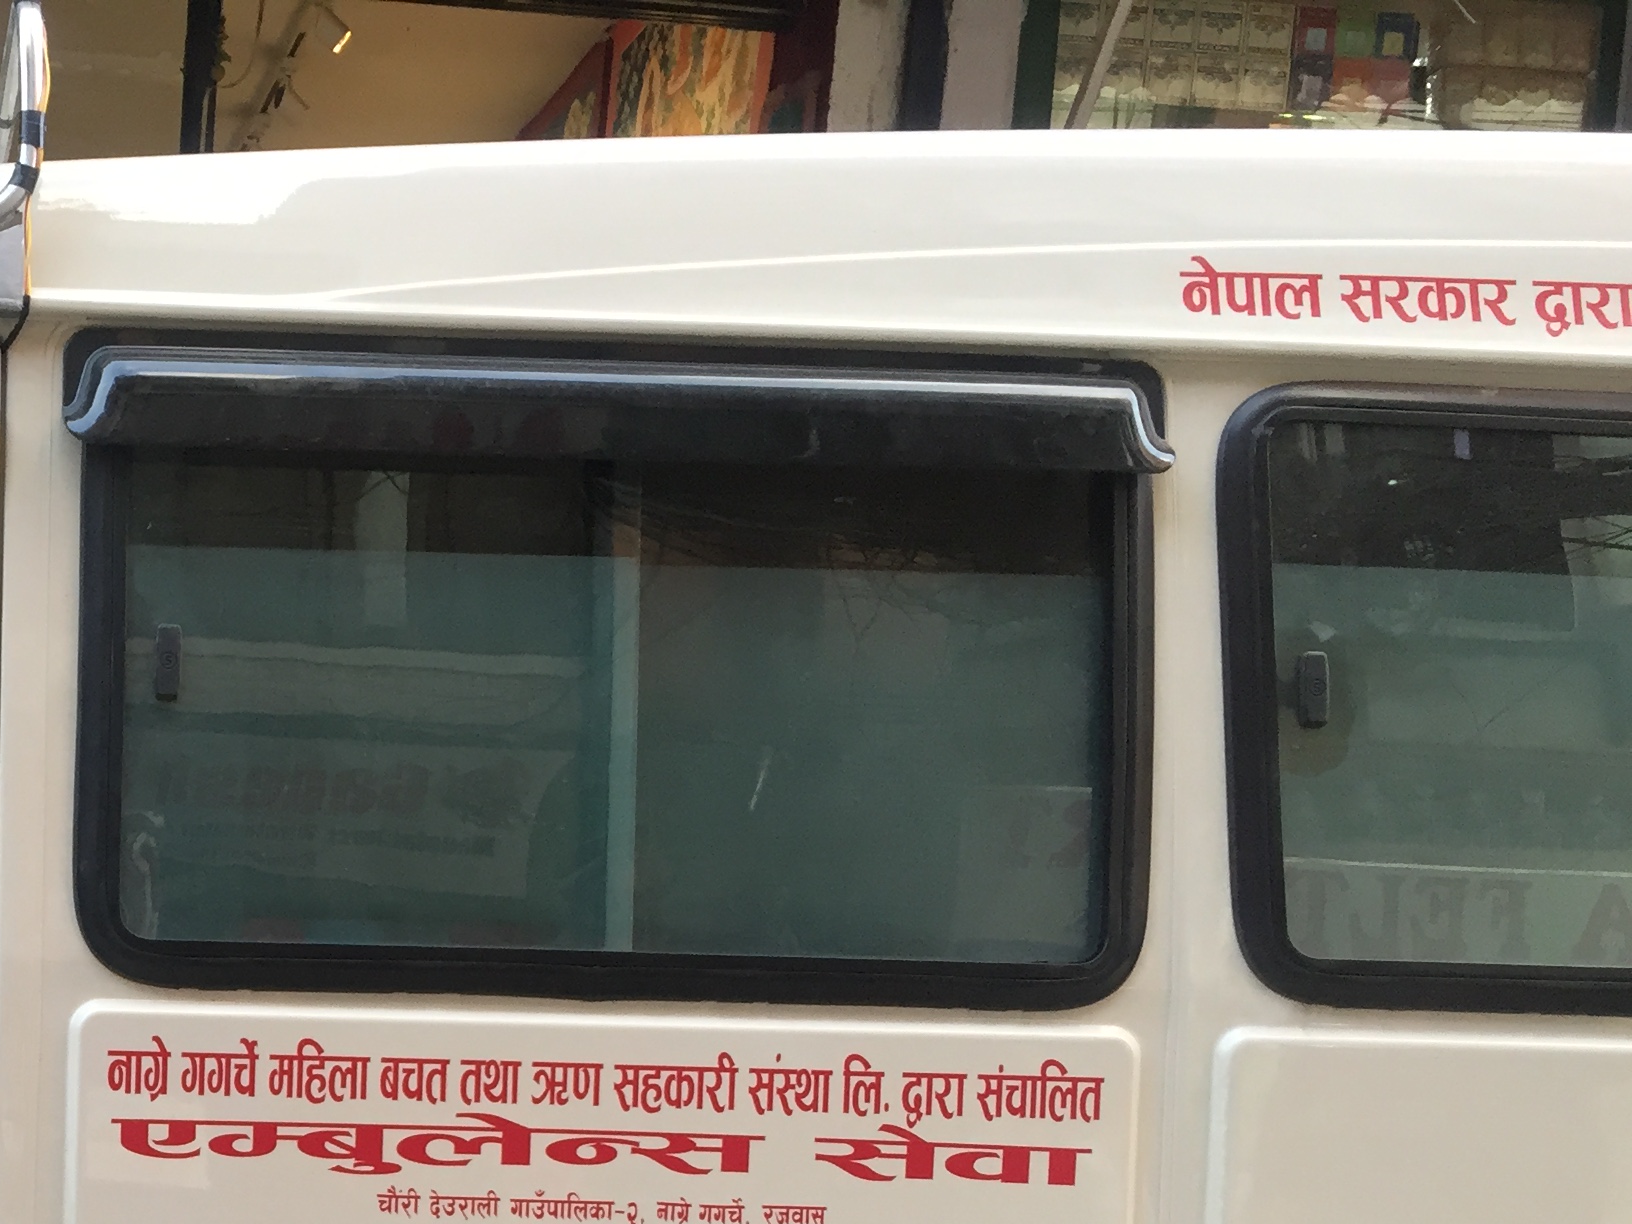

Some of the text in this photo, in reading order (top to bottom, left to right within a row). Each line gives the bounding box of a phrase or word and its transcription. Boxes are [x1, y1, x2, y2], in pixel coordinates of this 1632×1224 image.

[1180, 256, 1632, 338] नेपाल सरकार द्वारा
[107, 1035, 1104, 1128] नाग्रे गगर्चे महिला बचत तथा ऋण सहकारी संस्था लि. द्वारा संचालित
[111, 1112, 1093, 1188] एम्बुलेन्स सेवा
[429, 1188, 501, 1221] देउराली
[656, 1197, 692, 1224] नाग्रे
